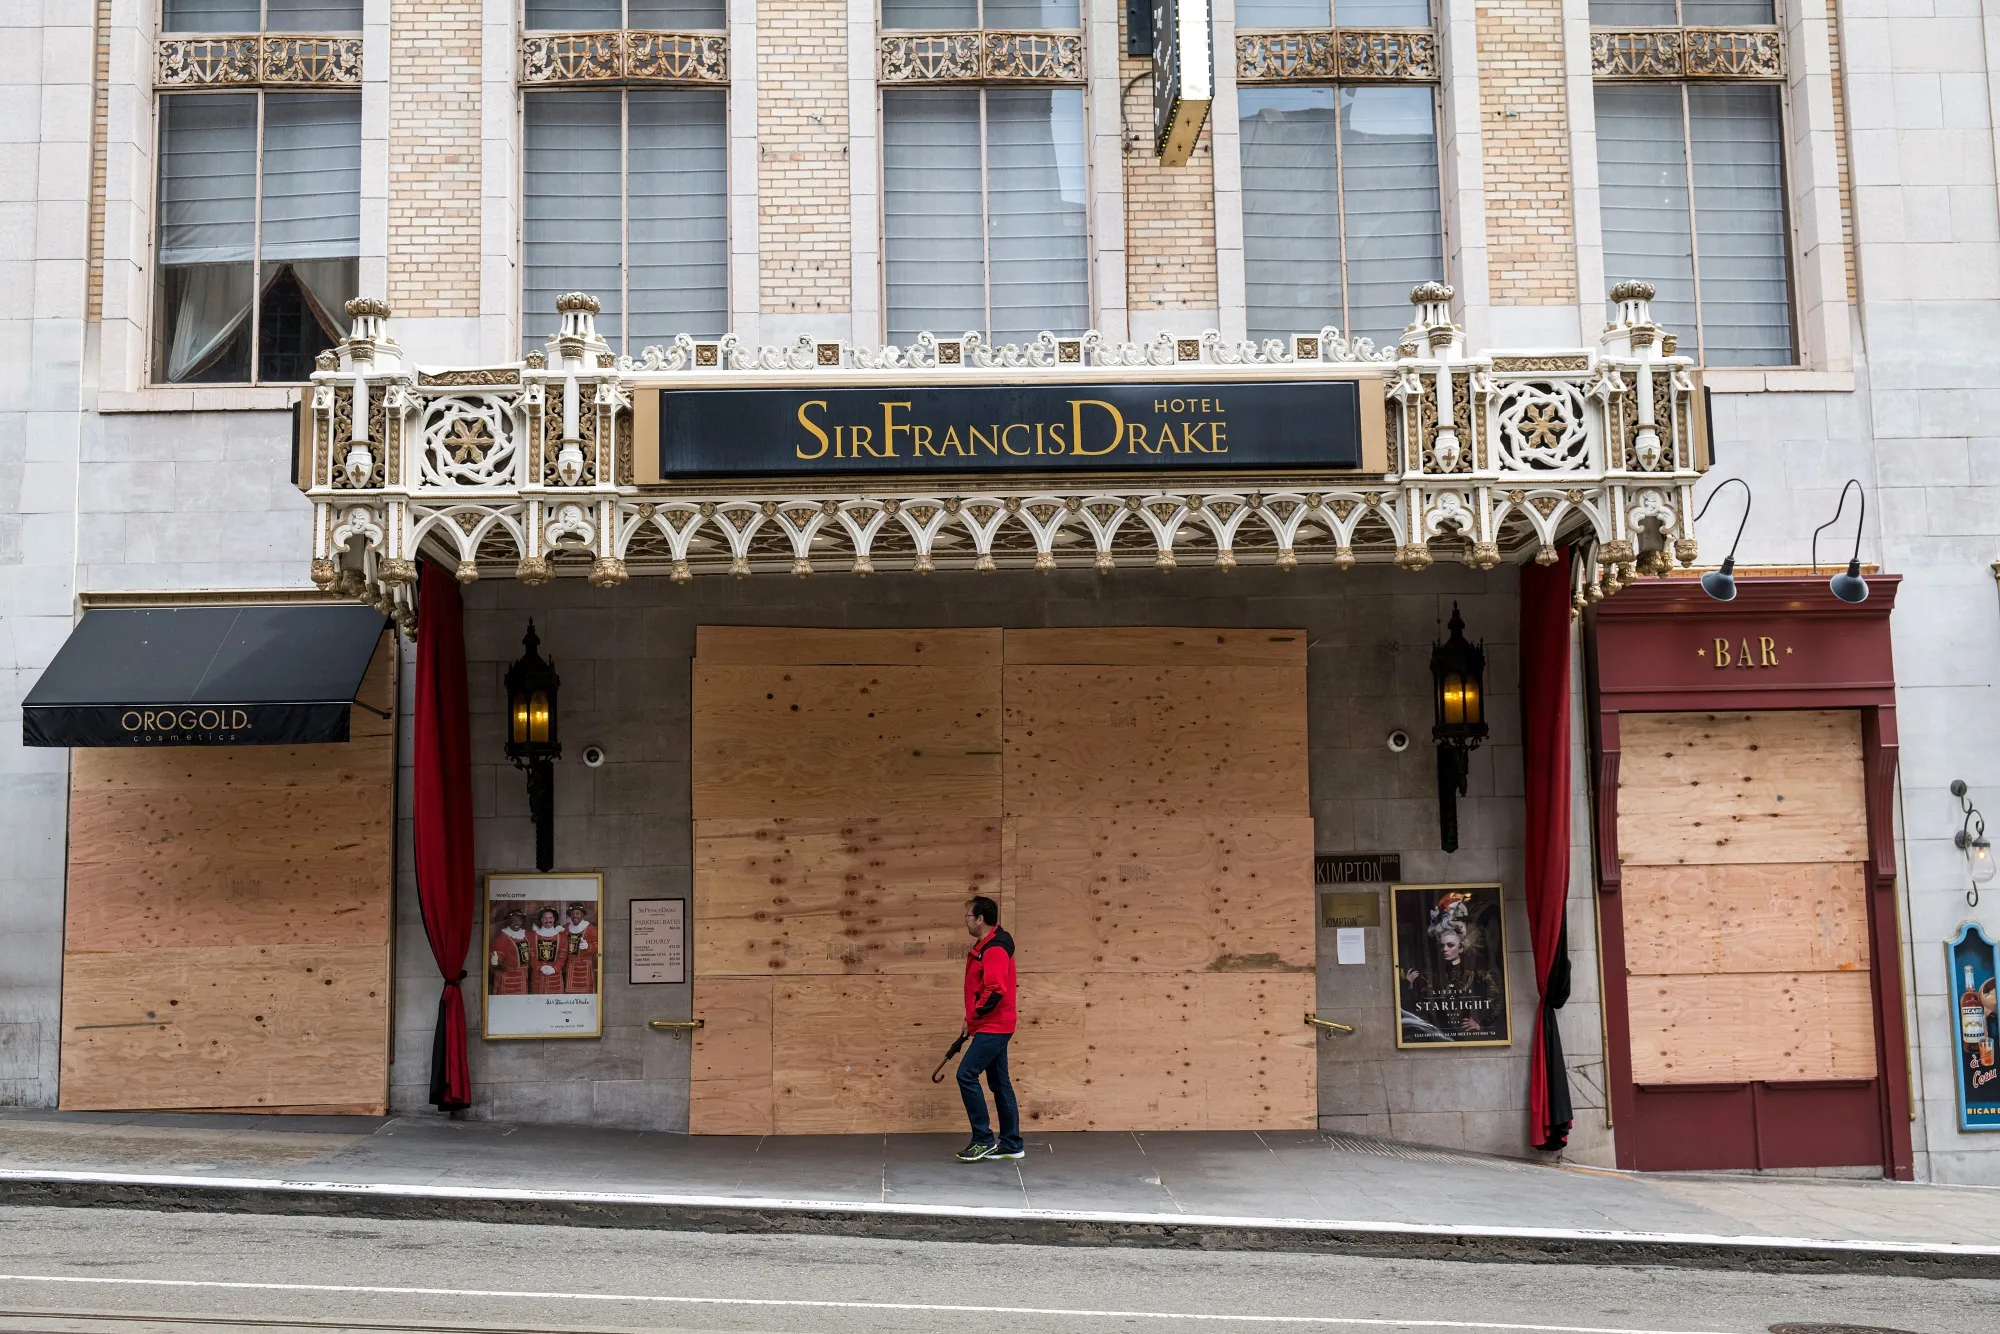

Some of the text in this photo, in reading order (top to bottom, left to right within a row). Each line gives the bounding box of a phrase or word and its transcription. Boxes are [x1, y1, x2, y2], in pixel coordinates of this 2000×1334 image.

[1154, 399, 1227, 415] HOTEL
[1714, 636, 1780, 667] BAR
[121, 709, 248, 731] OROGOLD
[133, 732, 235, 742] cosmetics
[1316, 861, 1383, 883] KIMPTON
[1325, 916, 1357, 928] KIMPTON
[1415, 1000, 1492, 1011] STARLIGHT
